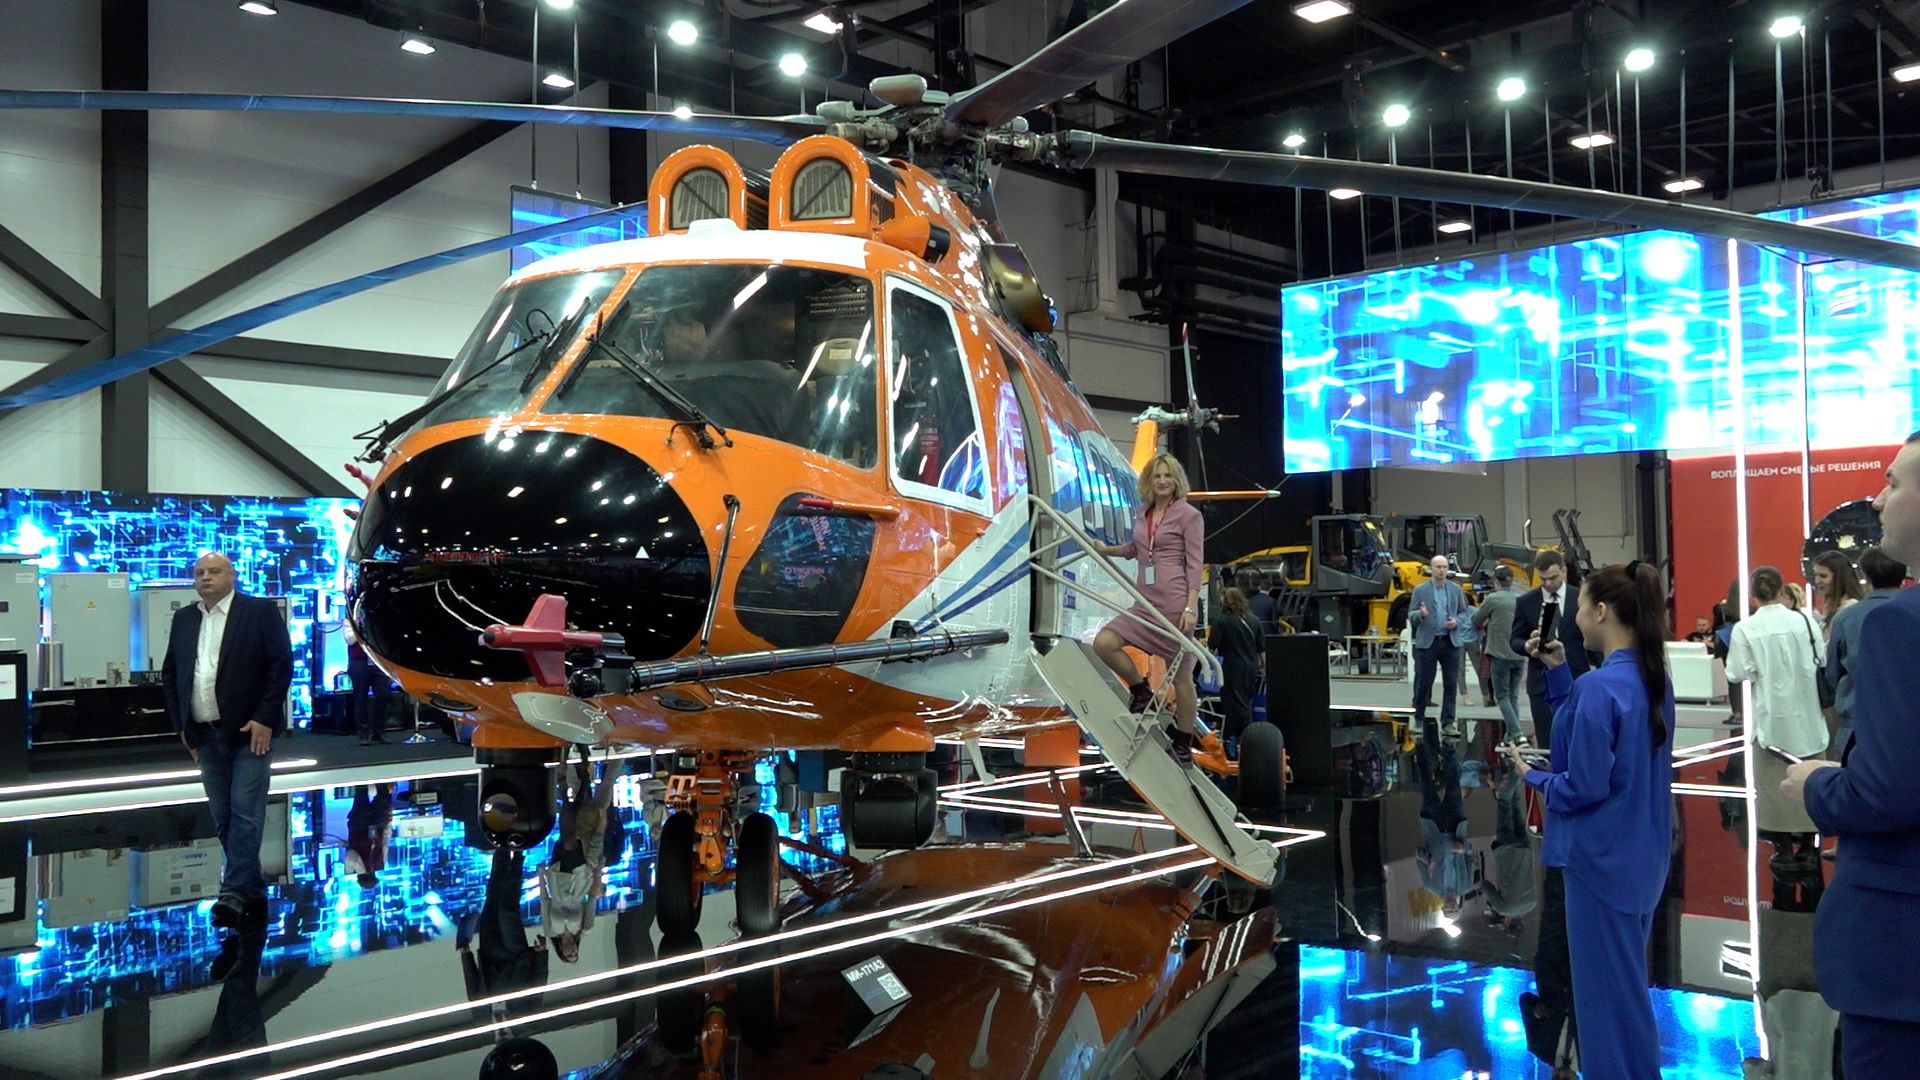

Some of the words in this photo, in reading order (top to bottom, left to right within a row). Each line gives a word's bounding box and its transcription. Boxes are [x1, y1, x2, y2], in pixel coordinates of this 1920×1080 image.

[1711, 467, 1778, 479] ВОПЛЩАЕМ
[1780, 464, 1825, 475] СМЕЫЕ
[1827, 460, 1881, 472] РЕШЕНИЯ
[846, 959, 885, 982] МИ-171А3
